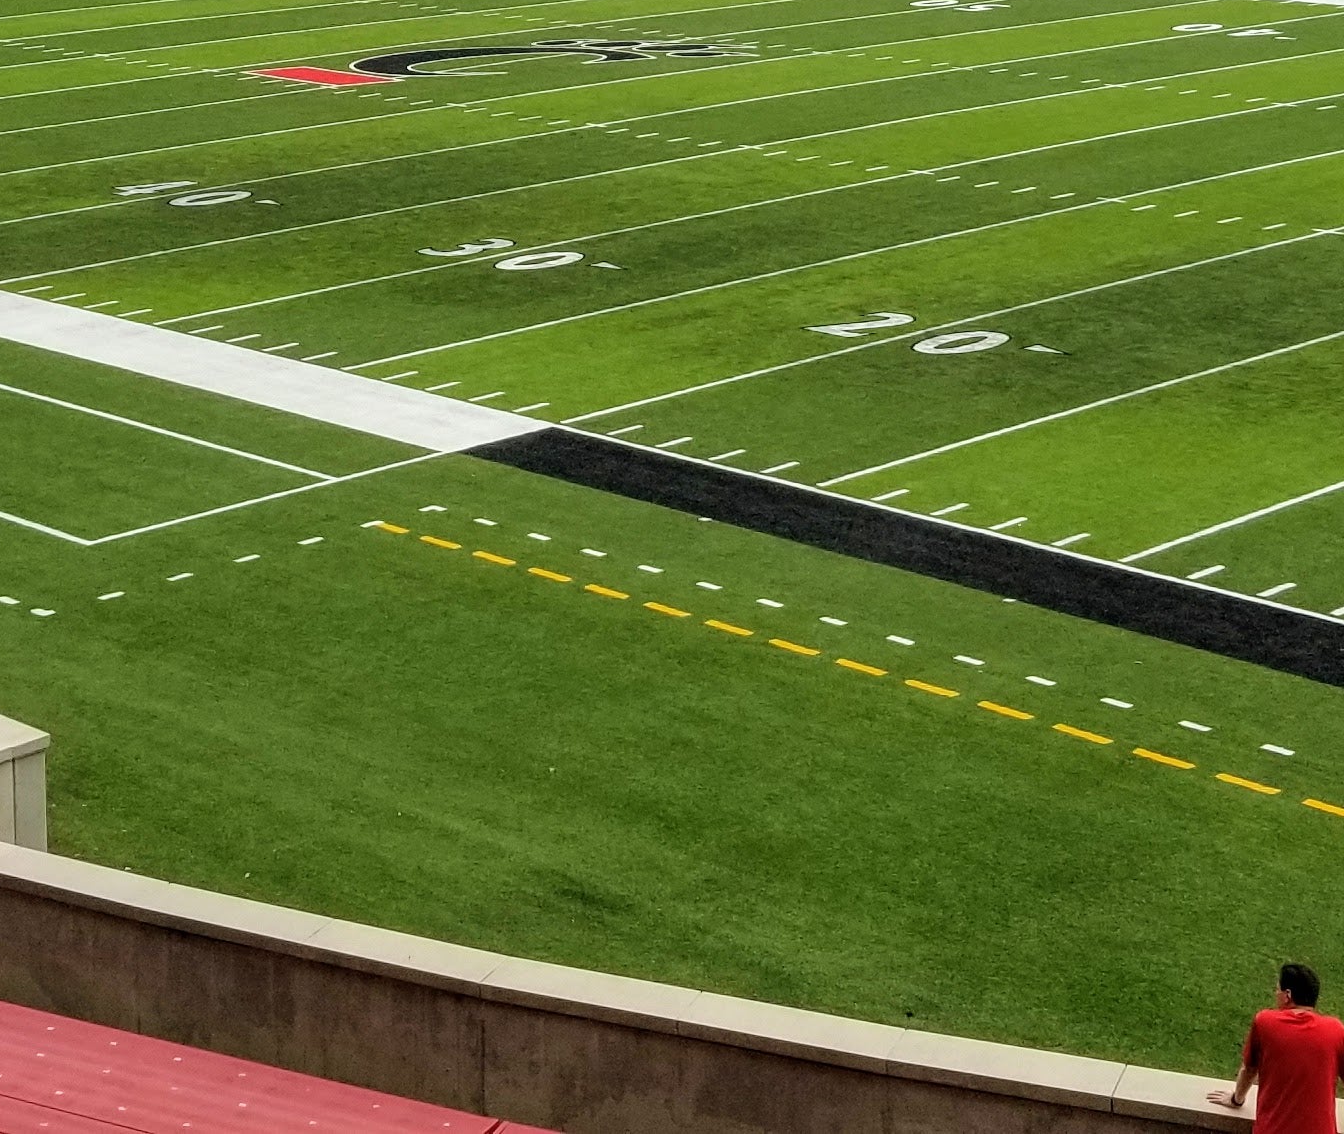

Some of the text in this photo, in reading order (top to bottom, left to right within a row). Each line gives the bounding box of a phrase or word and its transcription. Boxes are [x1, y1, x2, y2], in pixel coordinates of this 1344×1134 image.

[111, 179, 254, 208] 40
[416, 237, 587, 272] 30
[803, 309, 1013, 356] 20
